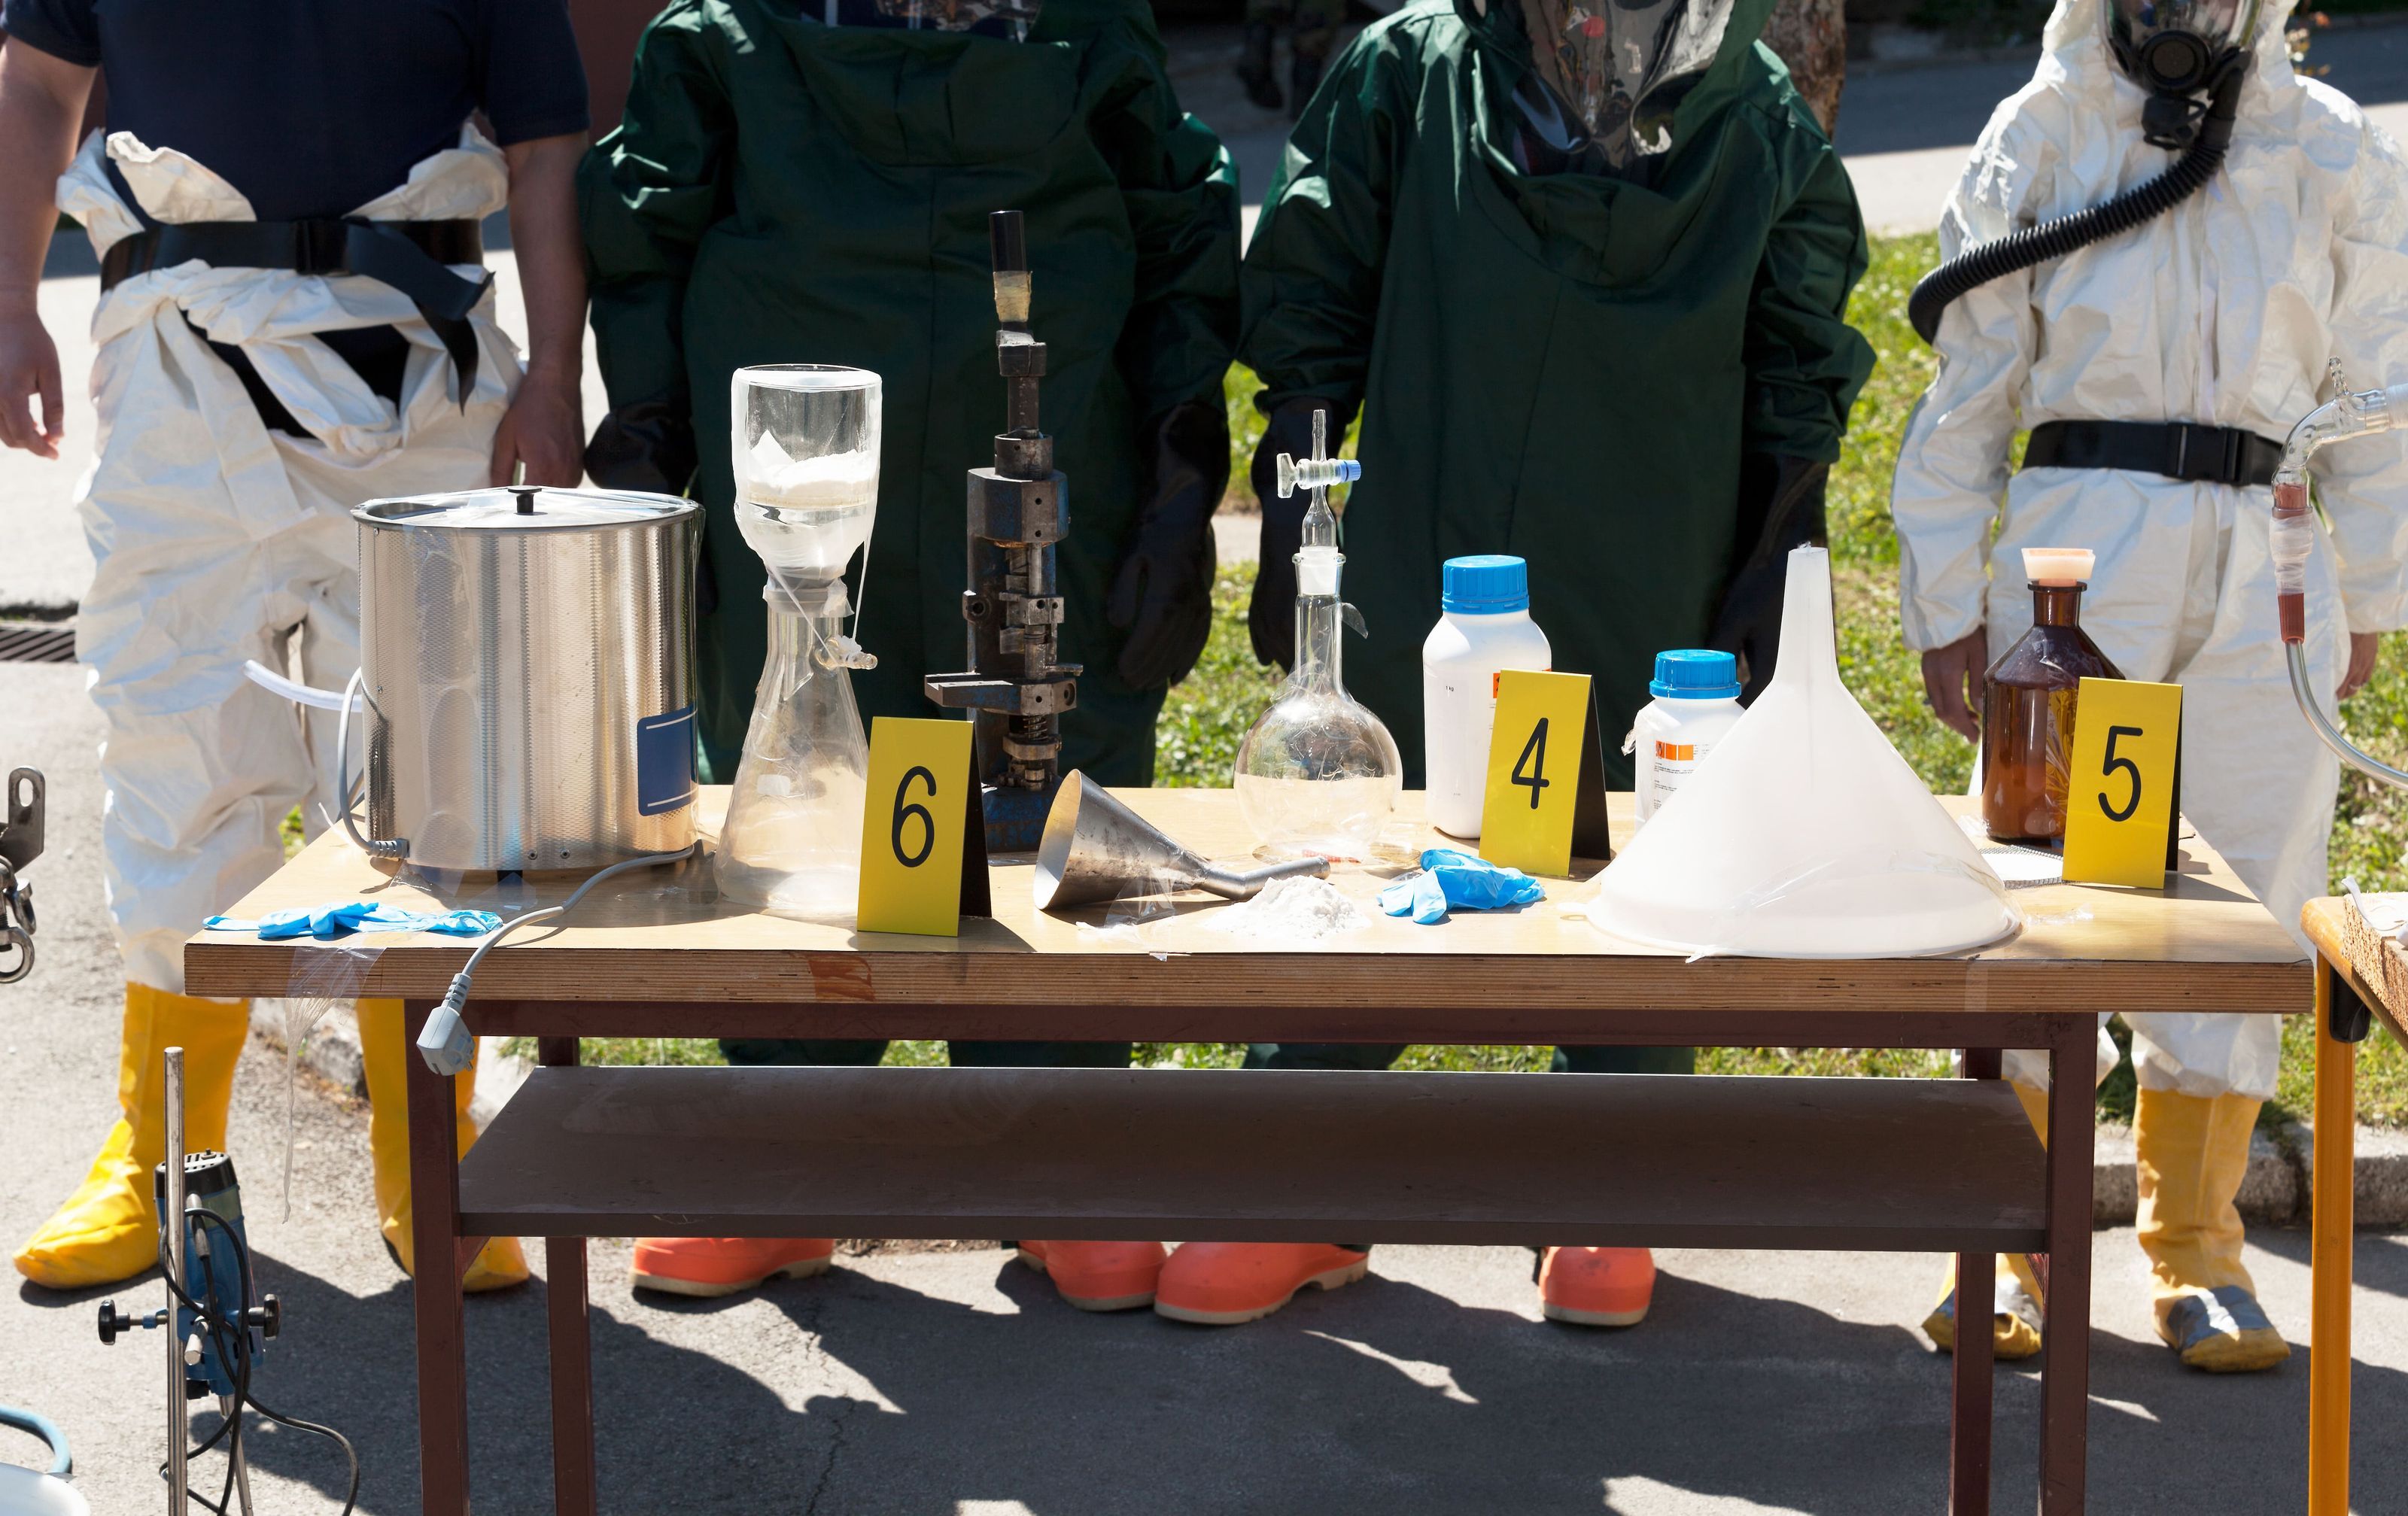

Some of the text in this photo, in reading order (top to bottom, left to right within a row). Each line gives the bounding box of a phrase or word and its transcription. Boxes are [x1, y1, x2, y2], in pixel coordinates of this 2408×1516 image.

[1511, 717, 1550, 810] 4
[2098, 725, 2144, 822] 5
[891, 765, 937, 868] 6
